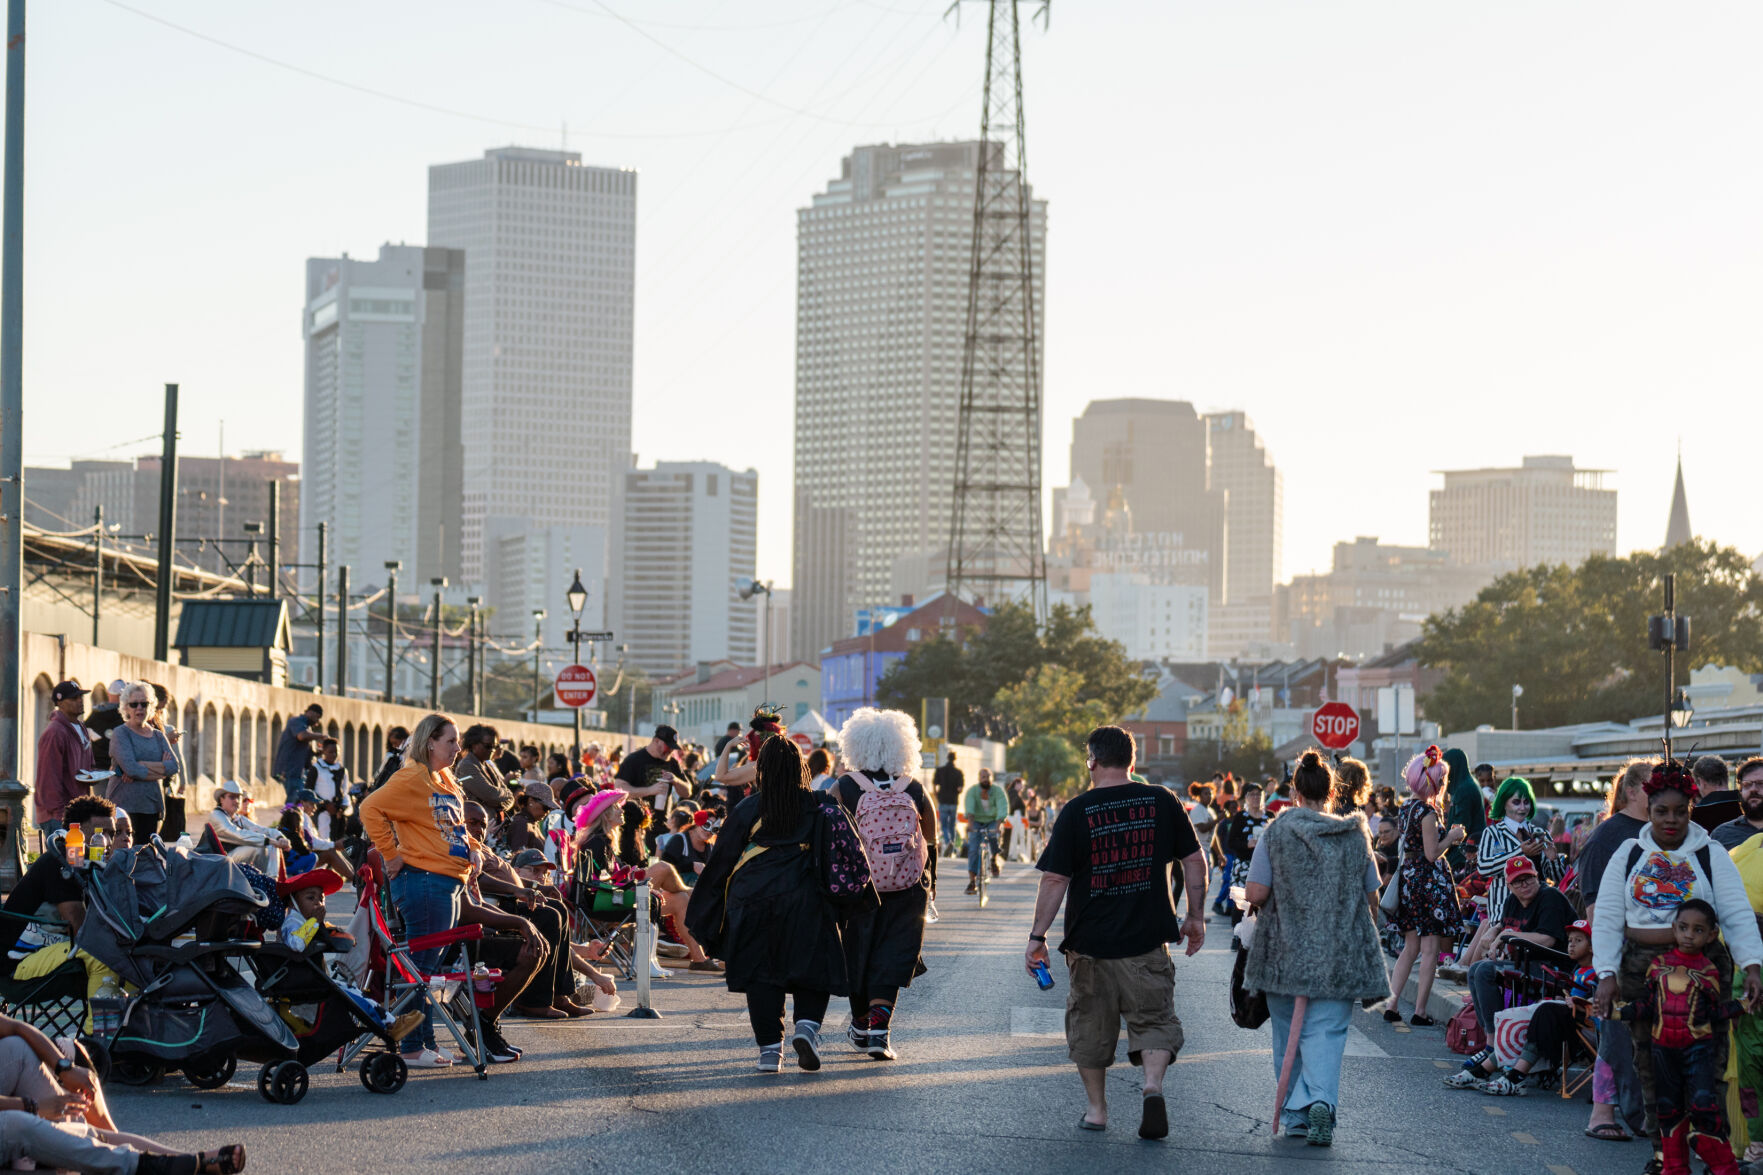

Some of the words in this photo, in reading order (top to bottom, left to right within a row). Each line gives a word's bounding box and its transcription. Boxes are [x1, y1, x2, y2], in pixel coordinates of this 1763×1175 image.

[562, 672, 573, 681] DO
[575, 672, 590, 681] NOT
[563, 691, 588, 699] ENTER
[1315, 715, 1357, 736] STOP
[1088, 810, 1120, 829] KILL
[1129, 806, 1156, 820] GOD
[1091, 834, 1118, 851] KILL
[1124, 829, 1154, 845] YOUR
[1091, 844, 1154, 865] MOM&DAD
[1091, 874, 1109, 888] KILL
[1111, 867, 1151, 885] YOURSELF
